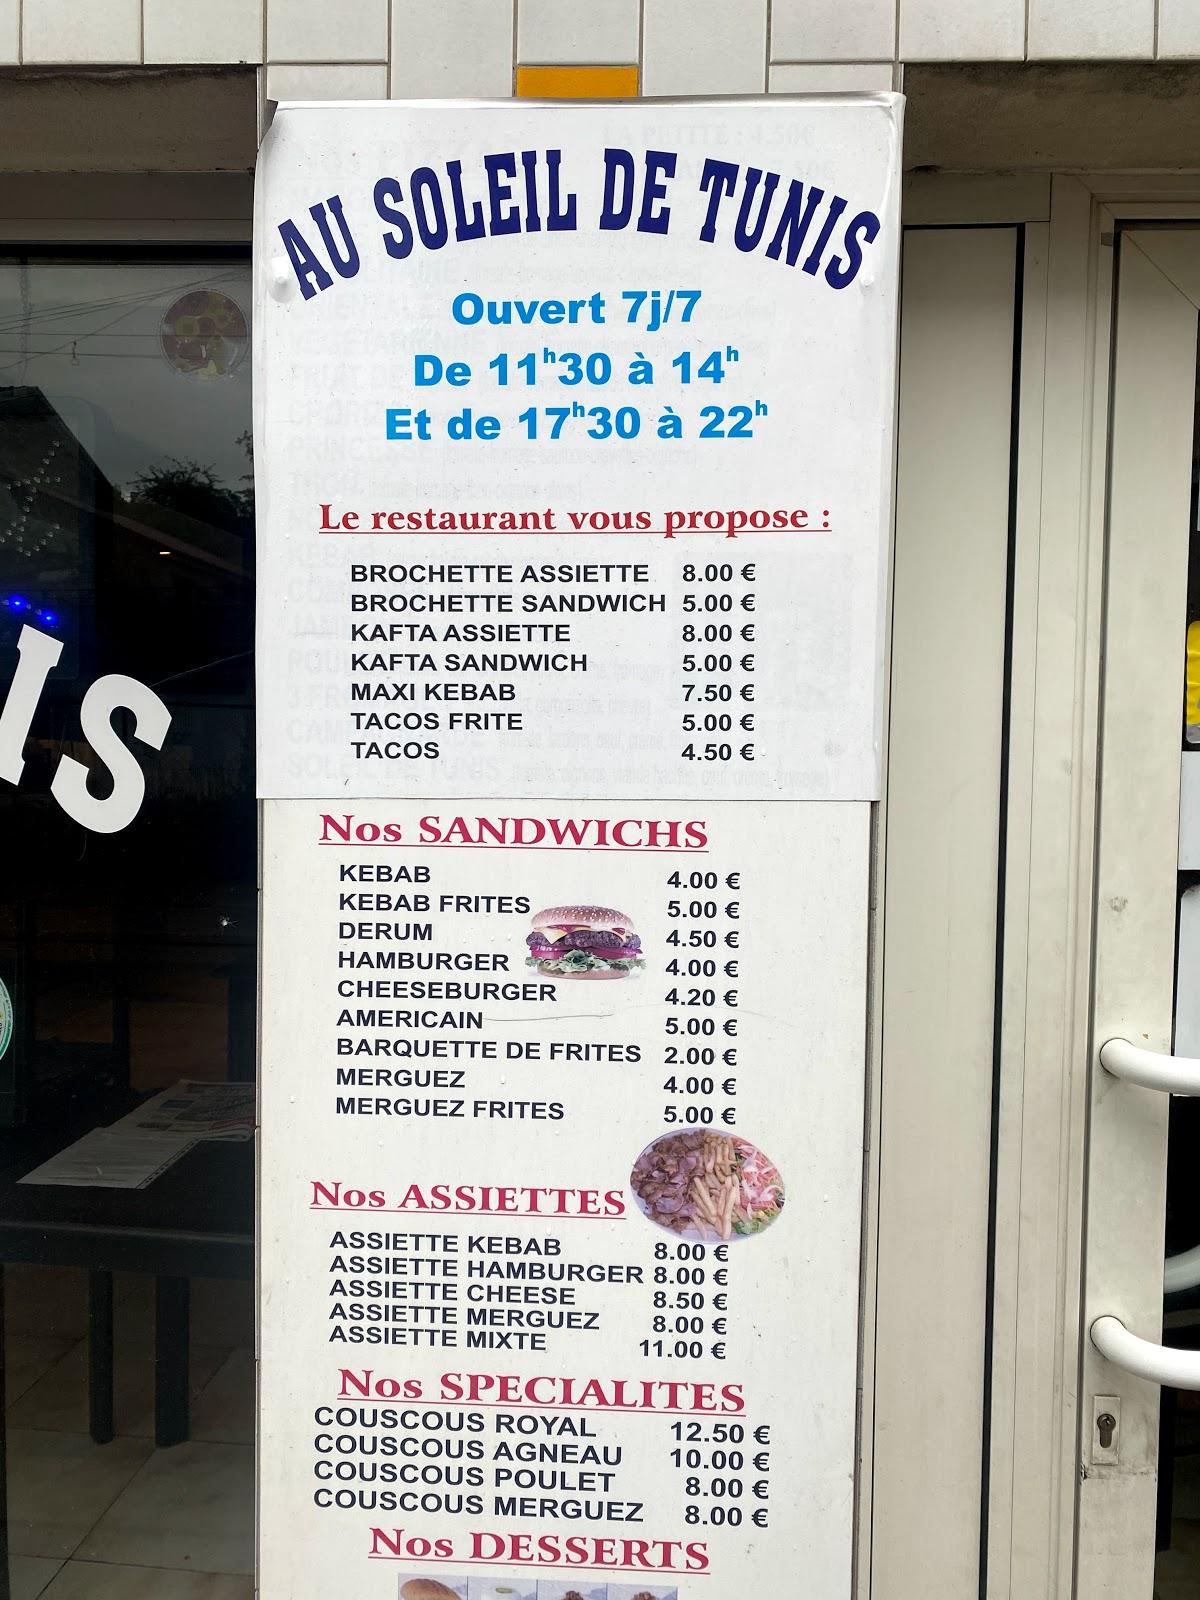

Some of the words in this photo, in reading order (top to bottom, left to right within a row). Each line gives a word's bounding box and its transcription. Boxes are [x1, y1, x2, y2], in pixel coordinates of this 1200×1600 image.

[277, 194, 361, 301] AU
[373, 149, 578, 260] SOLEIL
[598, 147, 678, 235] DE
[698, 157, 881, 290] TUNIS
[452, 291, 606, 326] Ouvert
[621, 289, 702, 332] 7j/7
[414, 354, 472, 387] De
[489, 347, 612, 386] 11h30
[627, 351, 654, 385] à
[672, 345, 739, 385] 14h
[385, 408, 432, 441] Et
[447, 407, 501, 441] de
[518, 401, 641, 440] 17h30
[656, 405, 683, 440] à
[699, 399, 768, 439] 22h
[319, 504, 360, 530] Le
[370, 508, 557, 531] restaurant
[566, 511, 652, 530] vous
[665, 508, 810, 538] propose
[351, 564, 513, 583] BROCHETTE
[519, 564, 649, 583] ASSIETTE
[682, 563, 733, 583] 8.00
[740, 563, 756, 582] €
[351, 594, 513, 613] BROCHETTE
[521, 594, 666, 613] SANDWICH
[682, 594, 733, 613] 5.00
[740, 593, 756, 612] €
[351, 623, 438, 642] KAFTA
[442, 624, 571, 642] ASSIETTE
[682, 624, 733, 643] 8.00
[739, 623, 755, 642] €
[351, 653, 438, 672] KAFTA
[444, 653, 587, 672] SANDWICH
[682, 654, 732, 672] 5.00
[739, 653, 755, 672] €
[351, 683, 415, 701] MAXI
[424, 683, 516, 701] KEBAB
[682, 684, 732, 702] 7.50
[739, 683, 755, 702] €
[350, 712, 440, 731] TACOS
[449, 712, 523, 731] FRITE
[682, 713, 732, 732] 5.00
[739, 713, 755, 732] €
[350, 741, 440, 760] TACOS
[681, 743, 732, 761] 4.50
[739, 743, 755, 761] €
[319, 814, 402, 843] Nos
[419, 815, 708, 849] SANDWICHS
[339, 864, 431, 883] KEBAB
[666, 870, 718, 890] 4.00
[725, 872, 741, 890] €
[339, 893, 431, 912] KEBAB
[439, 895, 531, 914] FRITES
[667, 900, 717, 919] 5.00
[724, 901, 740, 920] €
[339, 921, 433, 941] DERUM
[665, 929, 717, 948] 4.50
[723, 930, 740, 949] €
[338, 951, 510, 972] HAMBURGER
[665, 958, 716, 978] 4.00
[723, 960, 739, 978] €
[337, 979, 557, 1002] CHEESEBURGER
[664, 987, 716, 1007] 4.20
[722, 989, 738, 1008] €
[336, 1009, 483, 1029] AMERICAIN
[665, 1017, 715, 1036] 5.00
[722, 1018, 738, 1037] €
[337, 1038, 497, 1059] BARQUETTE
[506, 1041, 541, 1060] DE
[549, 1042, 642, 1063] FRITES
[663, 1046, 715, 1066] 2.00
[721, 1048, 737, 1067] €
[336, 1068, 466, 1089] MERGUEZ
[663, 1076, 714, 1095] 4.00
[721, 1077, 737, 1096] €
[336, 1096, 465, 1118] MERGUEZ
[473, 1100, 565, 1120] FRITES
[663, 1105, 714, 1125] 5.00
[720, 1107, 736, 1126] €
[309, 1181, 386, 1211] Nos
[398, 1184, 626, 1216] ASSIETTES
[329, 1231, 459, 1253] ASSIETTE
[468, 1235, 562, 1256] KEBAB
[654, 1242, 706, 1262] 8.00
[713, 1244, 729, 1263] €
[329, 1255, 458, 1277] ASSIETTE
[467, 1260, 644, 1284] HAMBURGER
[653, 1266, 705, 1286] 8.00
[712, 1268, 728, 1287] €
[329, 1279, 458, 1301] ASSIETTE
[466, 1284, 576, 1306] CHEESE
[653, 1291, 705, 1310] 8.50
[712, 1293, 728, 1311] €
[328, 1302, 458, 1325] ASSIETTE
[467, 1307, 600, 1330] MERGUEZ
[652, 1315, 704, 1335] 8.00
[711, 1317, 727, 1336] €
[328, 1325, 458, 1348] ASSIETTE
[466, 1330, 547, 1351] MIXTE
[639, 1339, 703, 1359] 11.00
[710, 1342, 726, 1360] €
[337, 1368, 423, 1399] Nos
[440, 1372, 745, 1413] SPECIALITES
[314, 1406, 485, 1433] COUSCOUS
[495, 1413, 597, 1438] ROYAL
[670, 1421, 745, 1444] 12.50
[752, 1425, 771, 1445] €
[314, 1433, 485, 1460] COUSCOUS
[492, 1441, 622, 1466] AGNEAU
[670, 1448, 744, 1471] 10.00
[752, 1452, 770, 1472] €
[314, 1460, 484, 1487] COUSCOUS
[494, 1468, 616, 1493] POULET
[685, 1476, 743, 1499] 8.00
[751, 1479, 770, 1500] €
[313, 1488, 484, 1515] COUSCOUS
[494, 1496, 644, 1523] MERGUEZ
[684, 1505, 743, 1527] 8.00
[751, 1508, 769, 1528] €
[367, 1527, 454, 1559] Nos
[469, 1532, 709, 1570] DESSERTS
